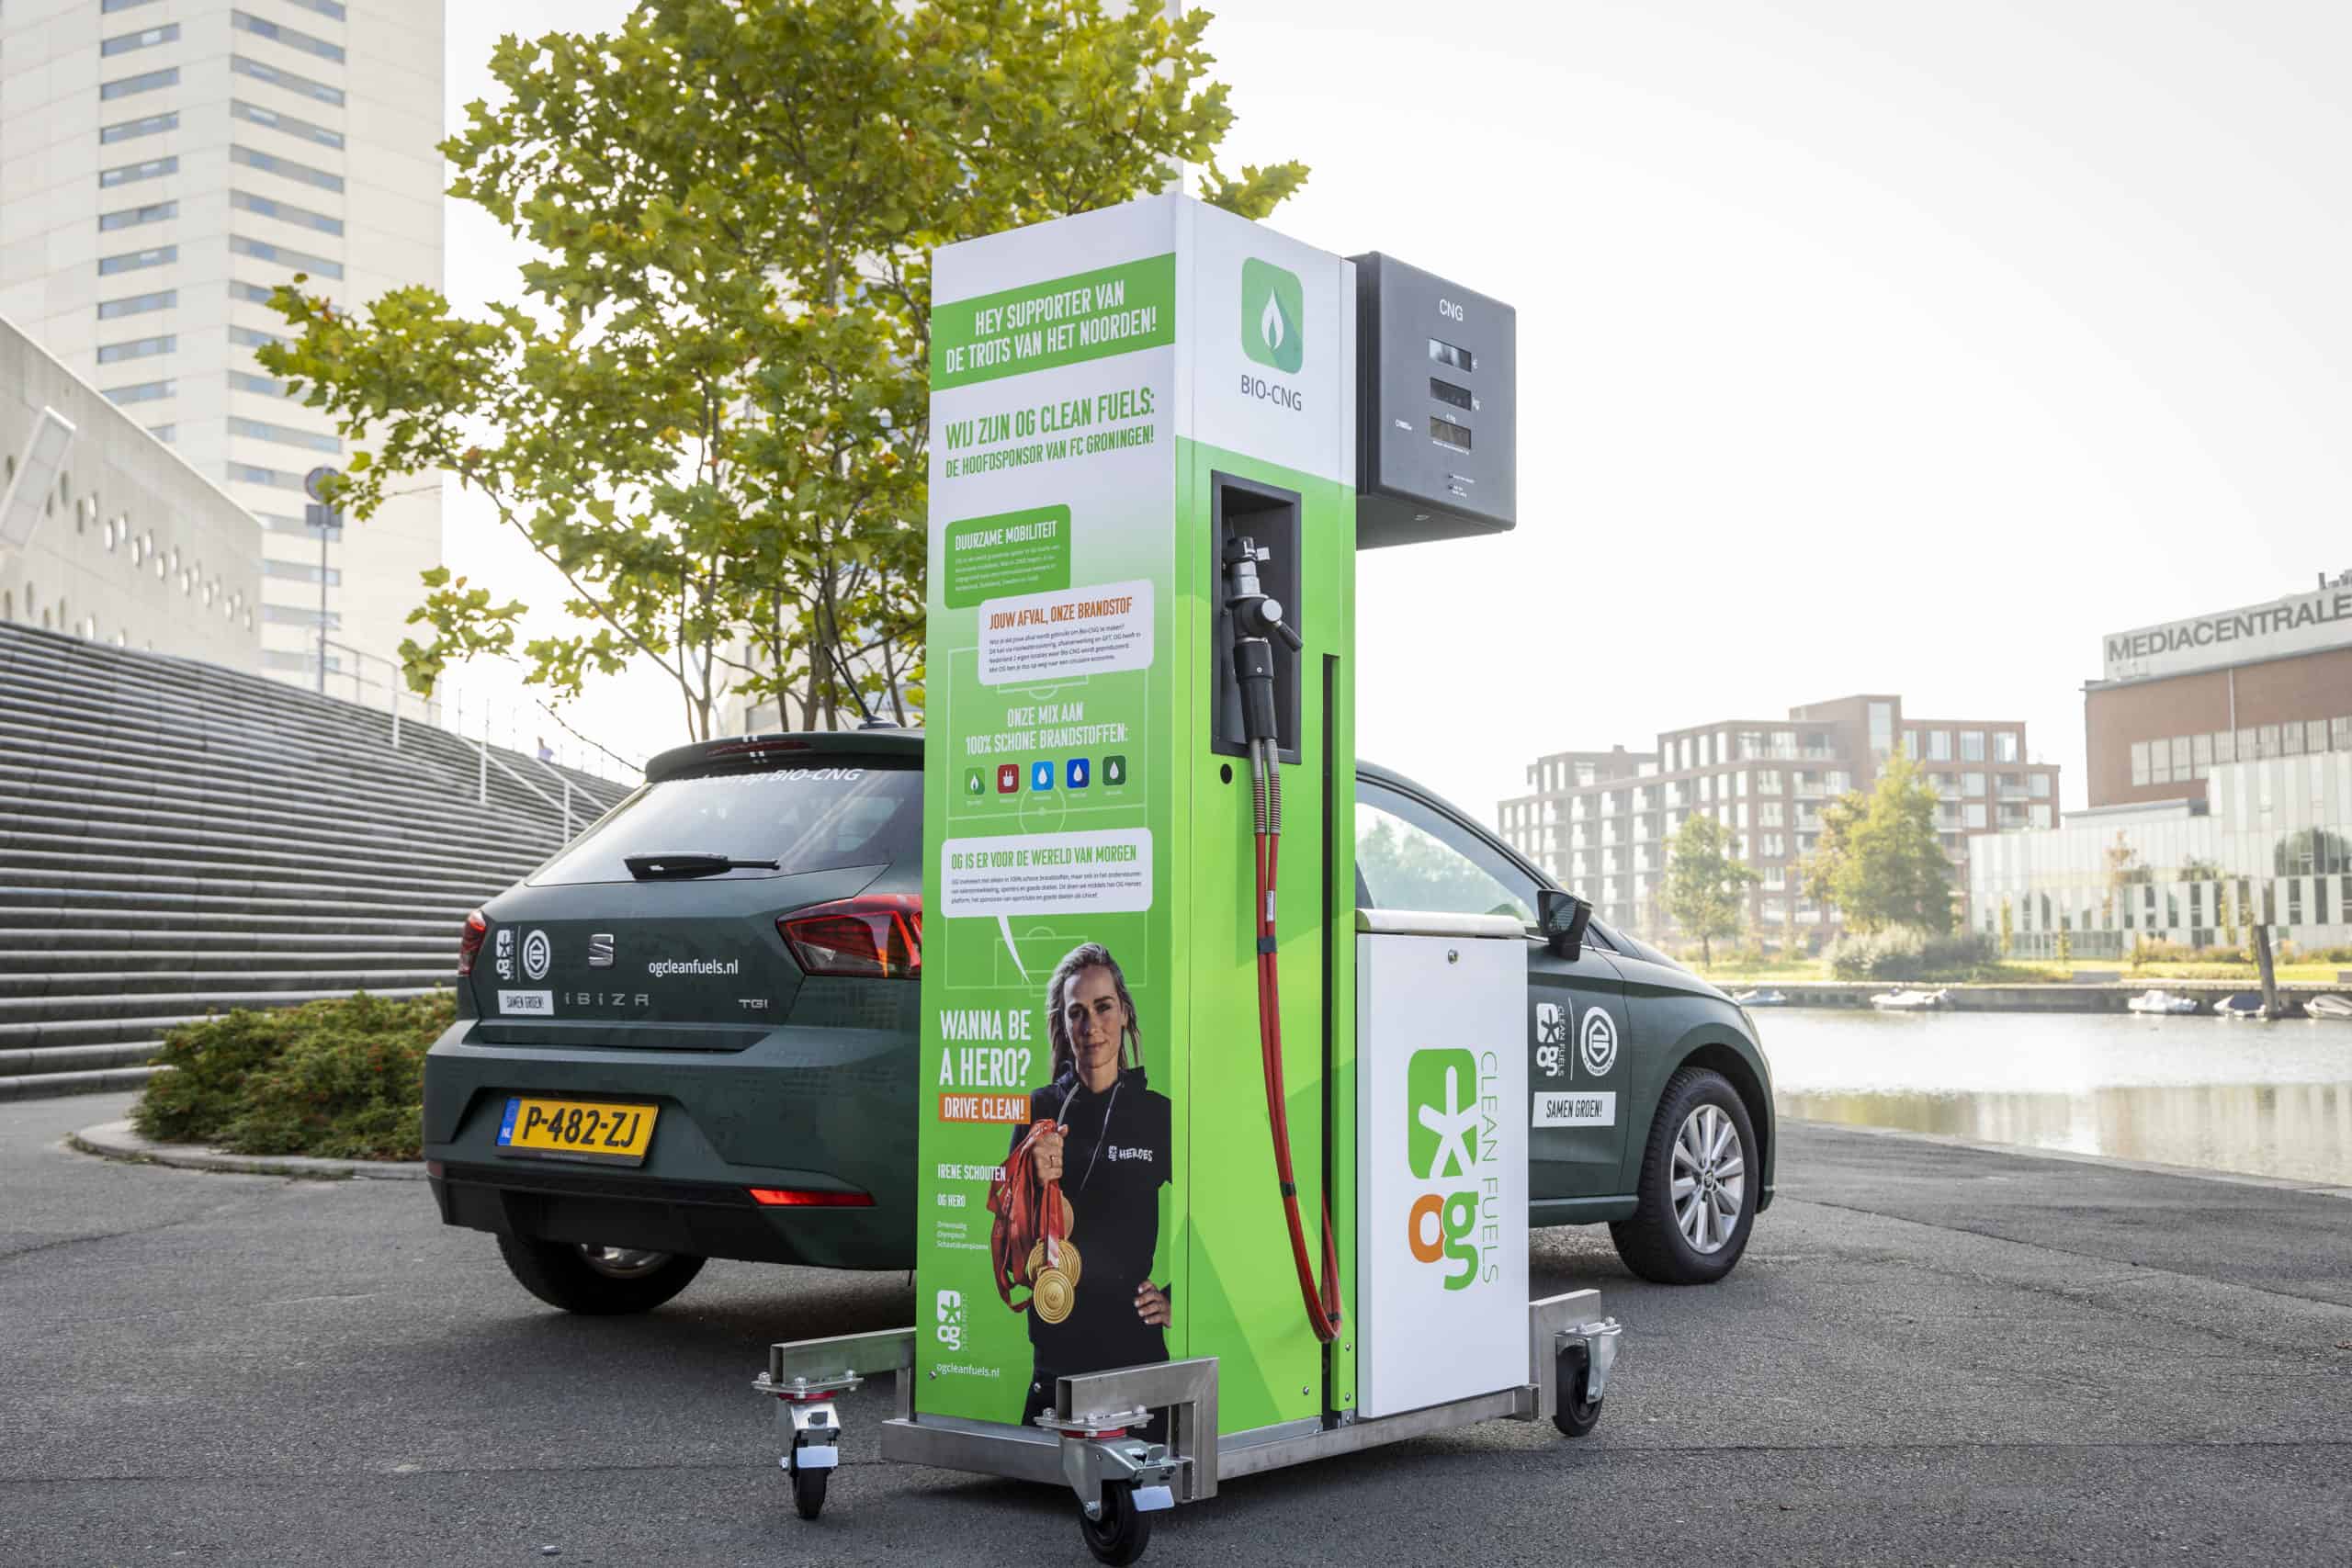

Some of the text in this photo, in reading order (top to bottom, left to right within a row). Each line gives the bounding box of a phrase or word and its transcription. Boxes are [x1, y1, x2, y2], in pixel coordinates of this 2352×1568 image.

[975, 279, 1125, 336] HEY SUPPORTER VAN
[1439, 299, 1464, 321] CNG
[945, 307, 1157, 374] DE TROTS VAN HET NOORDEN!
[1241, 374, 1302, 412] BIO-CNG
[944, 387, 1155, 450] WIJ ZIJN OG CLEAN FUELS:
[945, 424, 1154, 479] DE HOOFDSPONSOR VAN FC GRONINGEN!
[956, 520, 1057, 551] DUURZAME MOBILITEIT
[989, 597, 1133, 630] JOUW AFVAL, ONZE BRANDSTOF
[2108, 593, 2352, 662] MEDIACENTRALE
[1007, 702, 1084, 728] ONZE MIX AAN
[966, 735, 991, 756] 100%
[994, 730, 1037, 753] SCHONE
[770, 768, 865, 782] BIO-CNG
[951, 844, 1137, 870] OG IS ER VOOR DE WERELD VAN MORGEN
[648, 959, 739, 977] ogcleanfuels.nl
[565, 992, 650, 1007] IBIZA
[738, 998, 768, 1010] TGI
[940, 1010, 1032, 1041] WANNA BE
[939, 1047, 1031, 1088] A HERO?
[944, 1097, 1025, 1121] DRIVE CLEAN!
[1545, 1099, 1603, 1119] SAMEN GROEN!
[522, 1106, 640, 1147] P-482-ZJ
[1119, 1148, 1153, 1162] HEROES
[1480, 1051, 1499, 1284] CLEAN FUELS
[937, 1163, 1007, 1182] IRENE SCHOUTEN
[936, 1363, 1000, 1379] ogcleanfuels.nl
